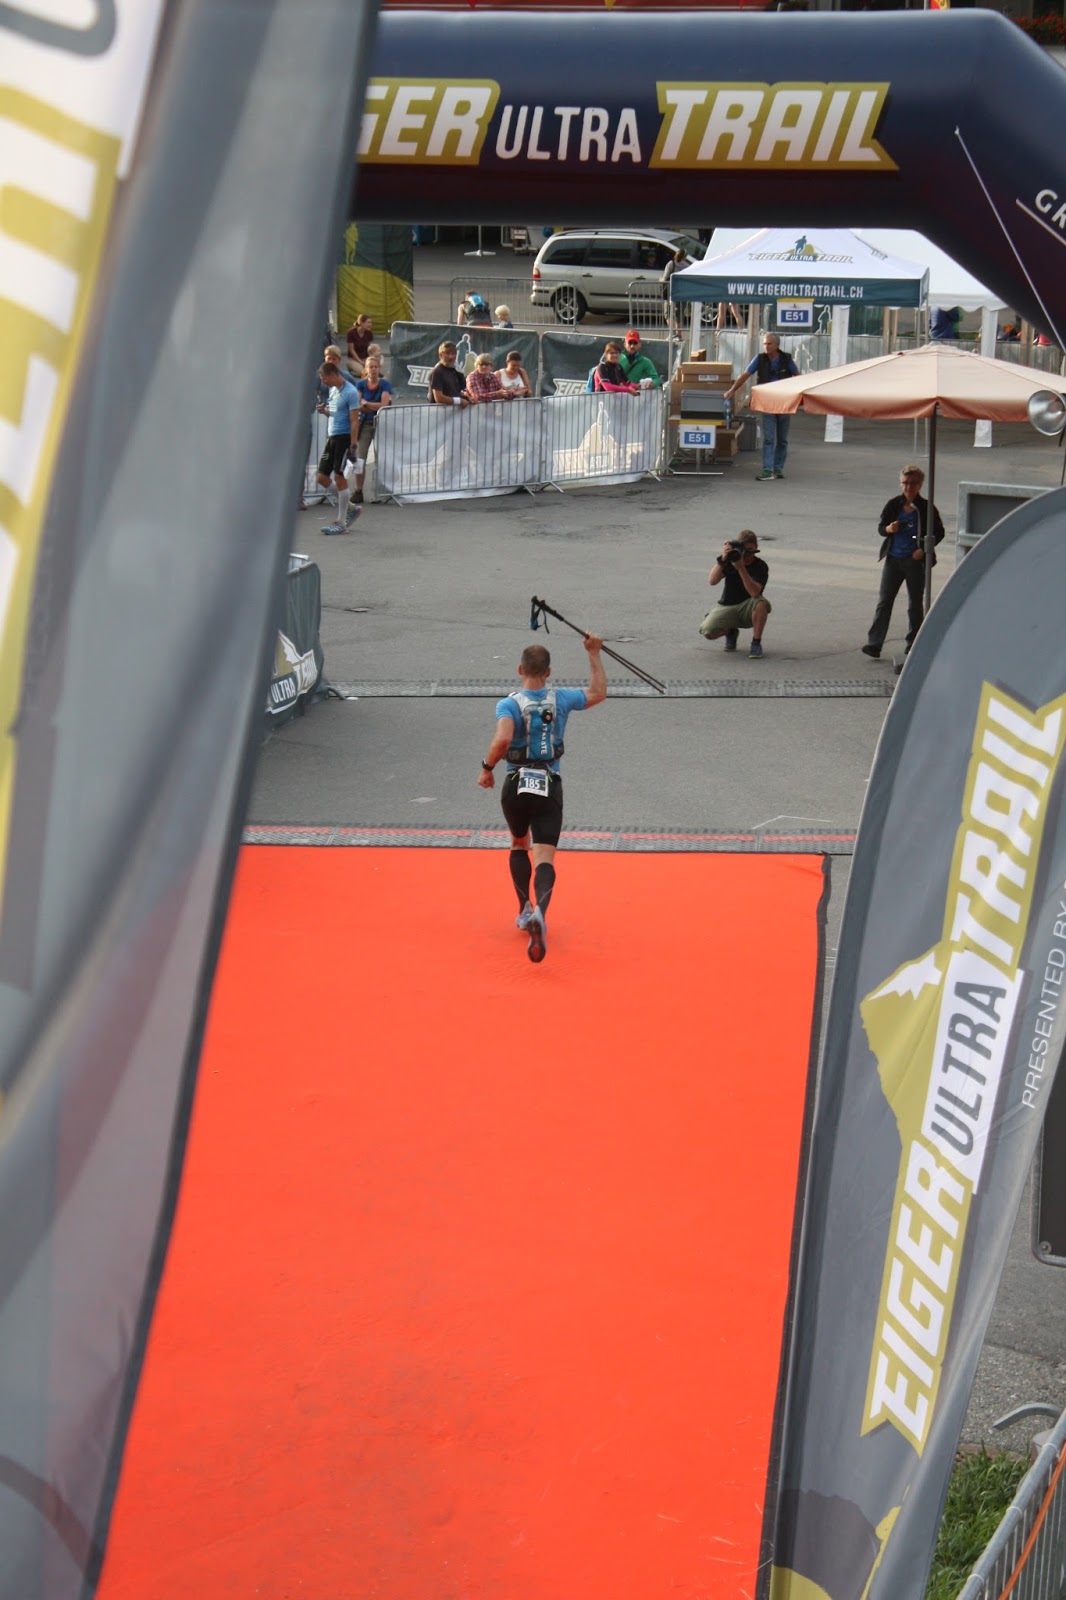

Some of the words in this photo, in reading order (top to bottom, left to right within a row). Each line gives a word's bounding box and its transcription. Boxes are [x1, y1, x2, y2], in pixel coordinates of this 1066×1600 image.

[357, 85, 492, 157] GER
[495, 104, 642, 164] ULTRA
[659, 90, 882, 161] TRAIL
[750, 253, 790, 261] EIGER
[816, 254, 853, 263] TRAIL
[727, 283, 864, 298] WWW.EIGERULTRATRAIL.CH
[785, 311, 804, 320] E51
[688, 433, 706, 443] E51
[271, 678, 296, 703] ULTRA
[523, 777, 540, 789] 185
[950, 697, 1063, 966] TRAIL
[1022, 948, 1066, 1108] PRESENTED
[929, 981, 1006, 1156] ULTRA
[869, 1140, 967, 1442] EIGER
